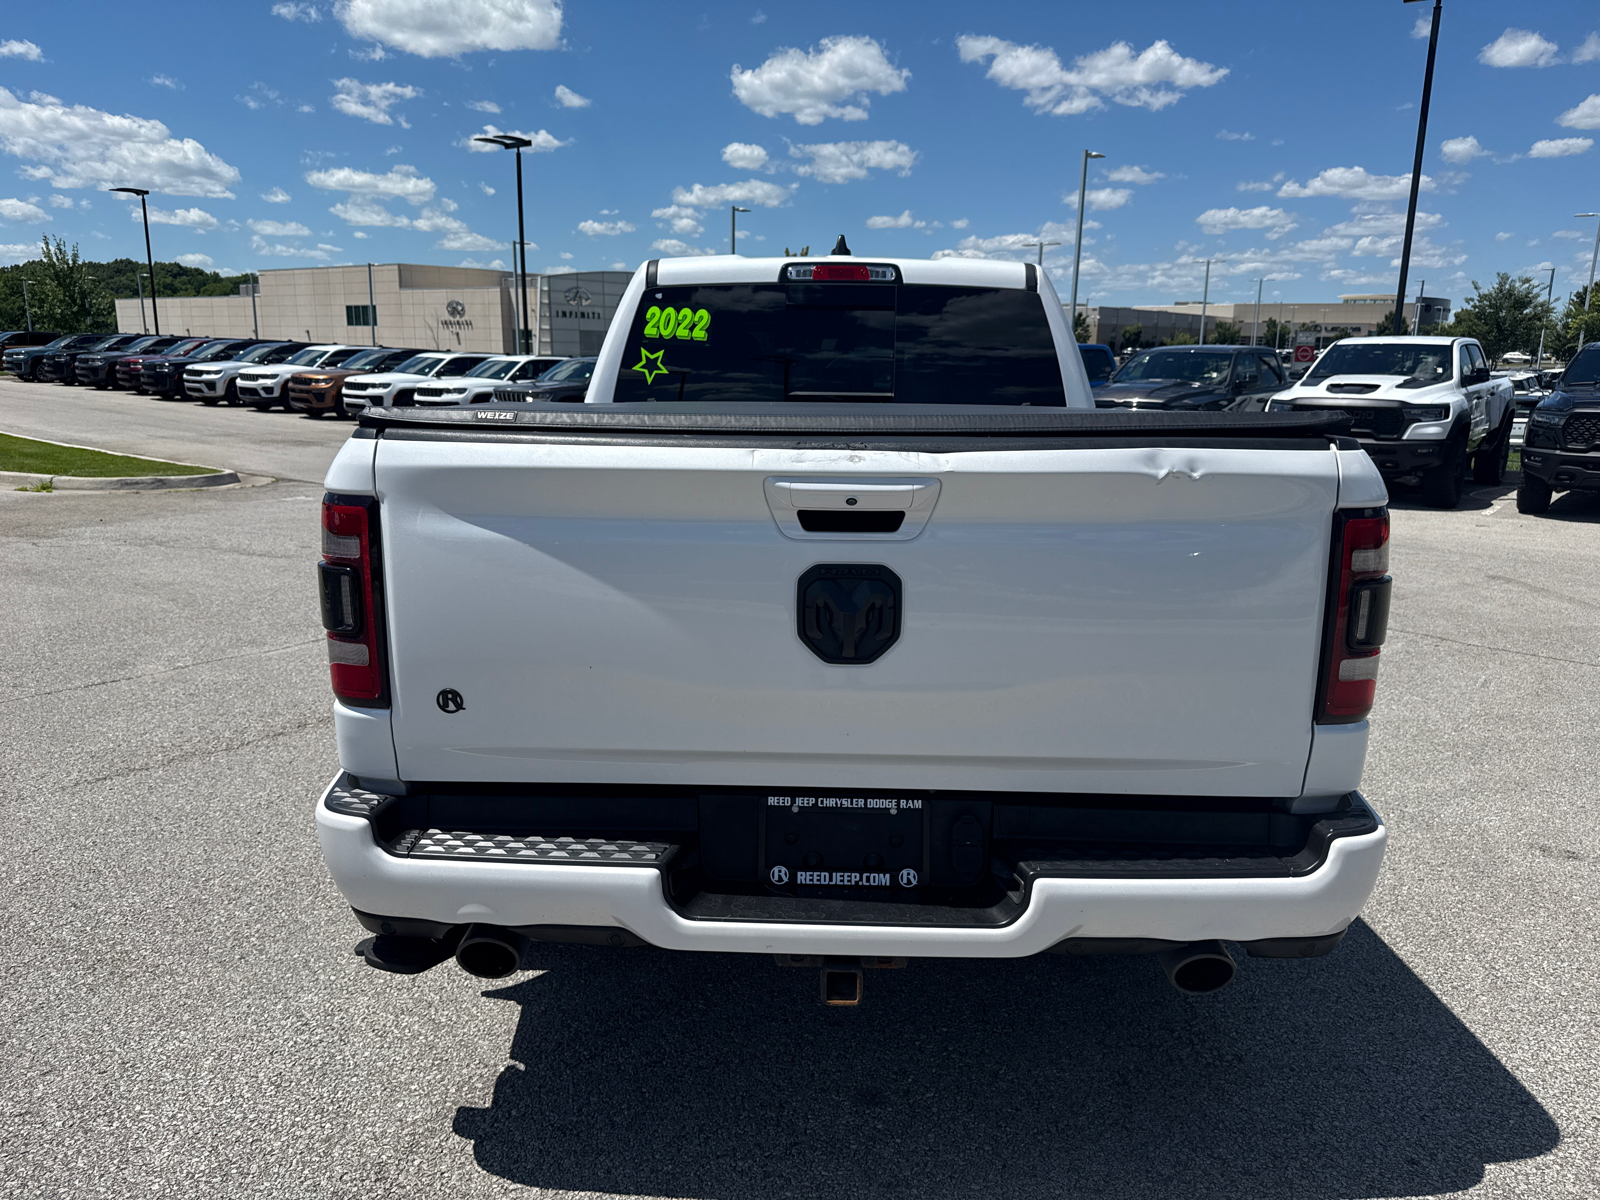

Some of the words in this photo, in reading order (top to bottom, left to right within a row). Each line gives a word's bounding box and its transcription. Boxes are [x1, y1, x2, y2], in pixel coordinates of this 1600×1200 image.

[556, 310, 601, 320] INFINITI
[643, 305, 712, 342] 2022
[819, 567, 881, 576] RAM
[767, 796, 791, 806] REED
[793, 797, 815, 807] JEEP
[818, 797, 865, 808] CHRYSLER
[867, 798, 898, 808] DODGE
[900, 799, 922, 809] RAM
[797, 871, 890, 886] REEDJEEP.COM
